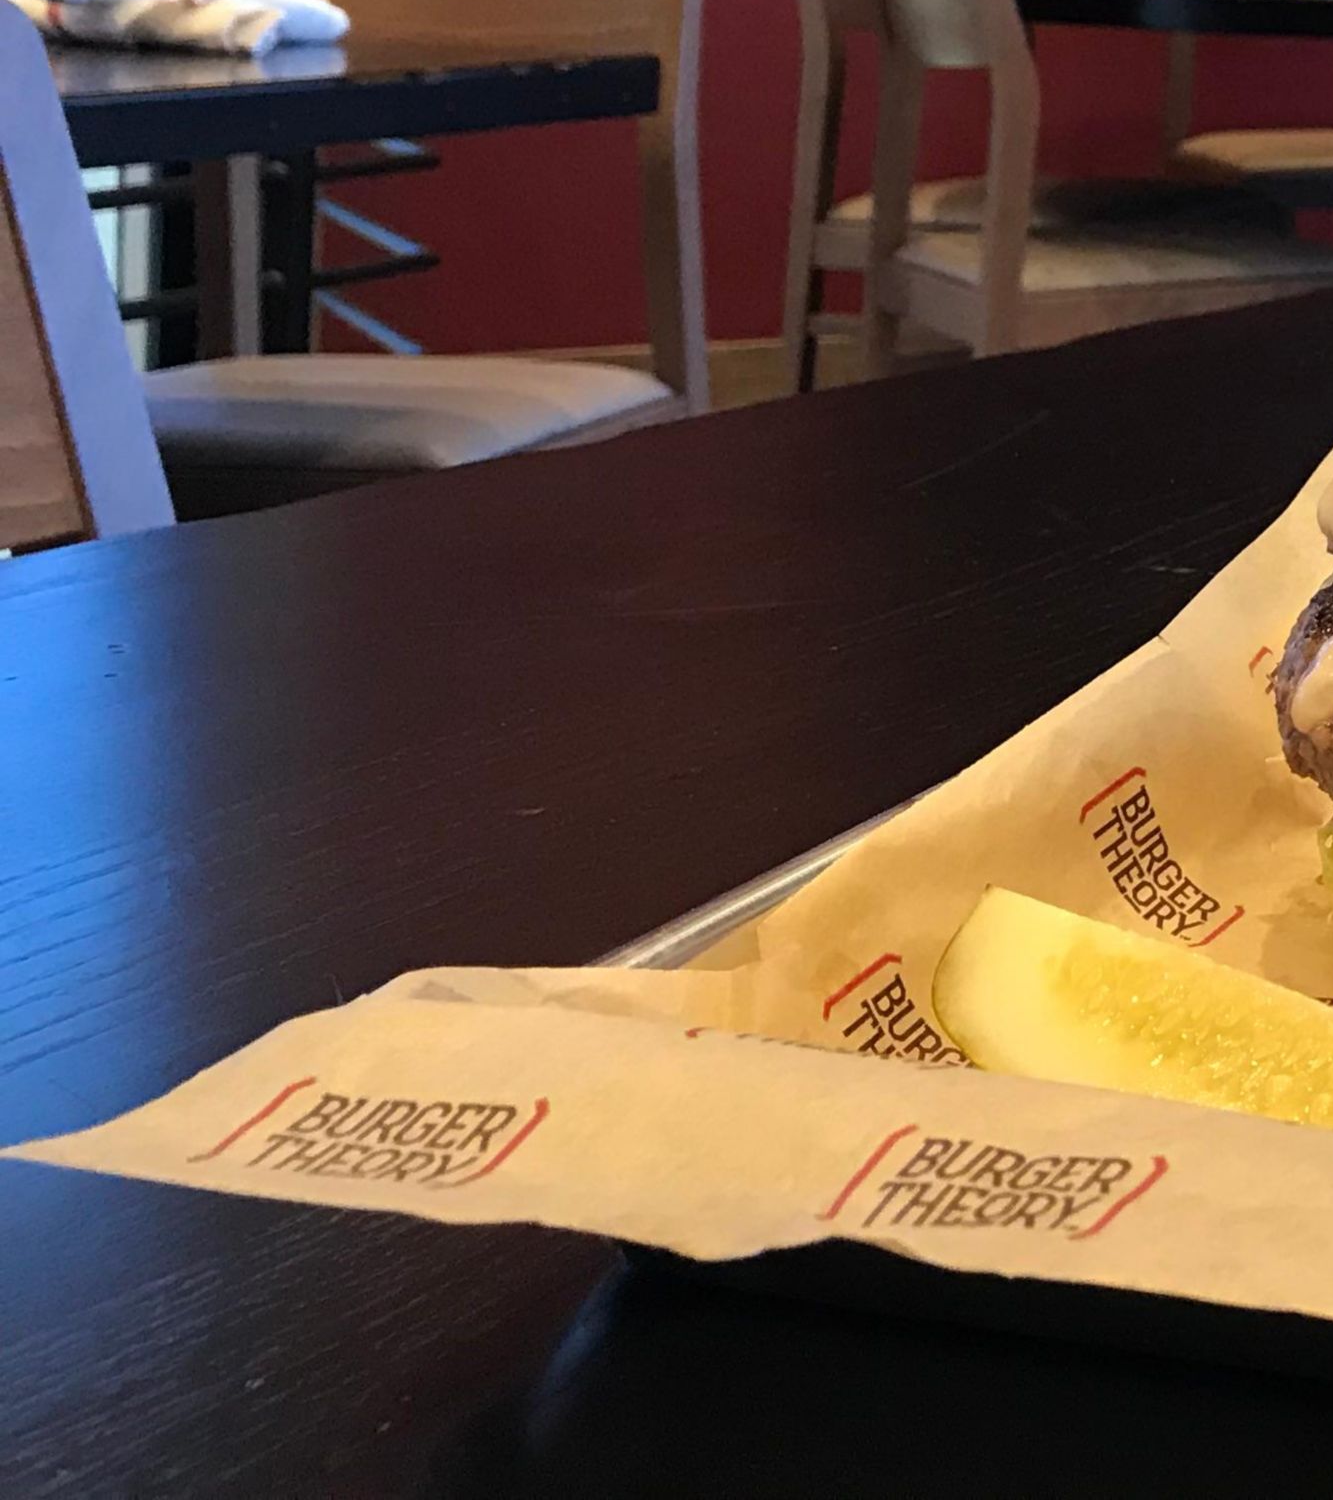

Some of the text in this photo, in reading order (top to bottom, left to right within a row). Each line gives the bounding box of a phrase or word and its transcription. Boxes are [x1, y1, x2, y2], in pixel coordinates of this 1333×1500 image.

[1092, 805, 1206, 940] THEORY
[1117, 784, 1221, 922] BURGER
[285, 1092, 518, 1153] BURGER
[247, 1134, 478, 1185] THEORY
[895, 1137, 1134, 1197] BURGER
[861, 1181, 1093, 1233] THEORY
